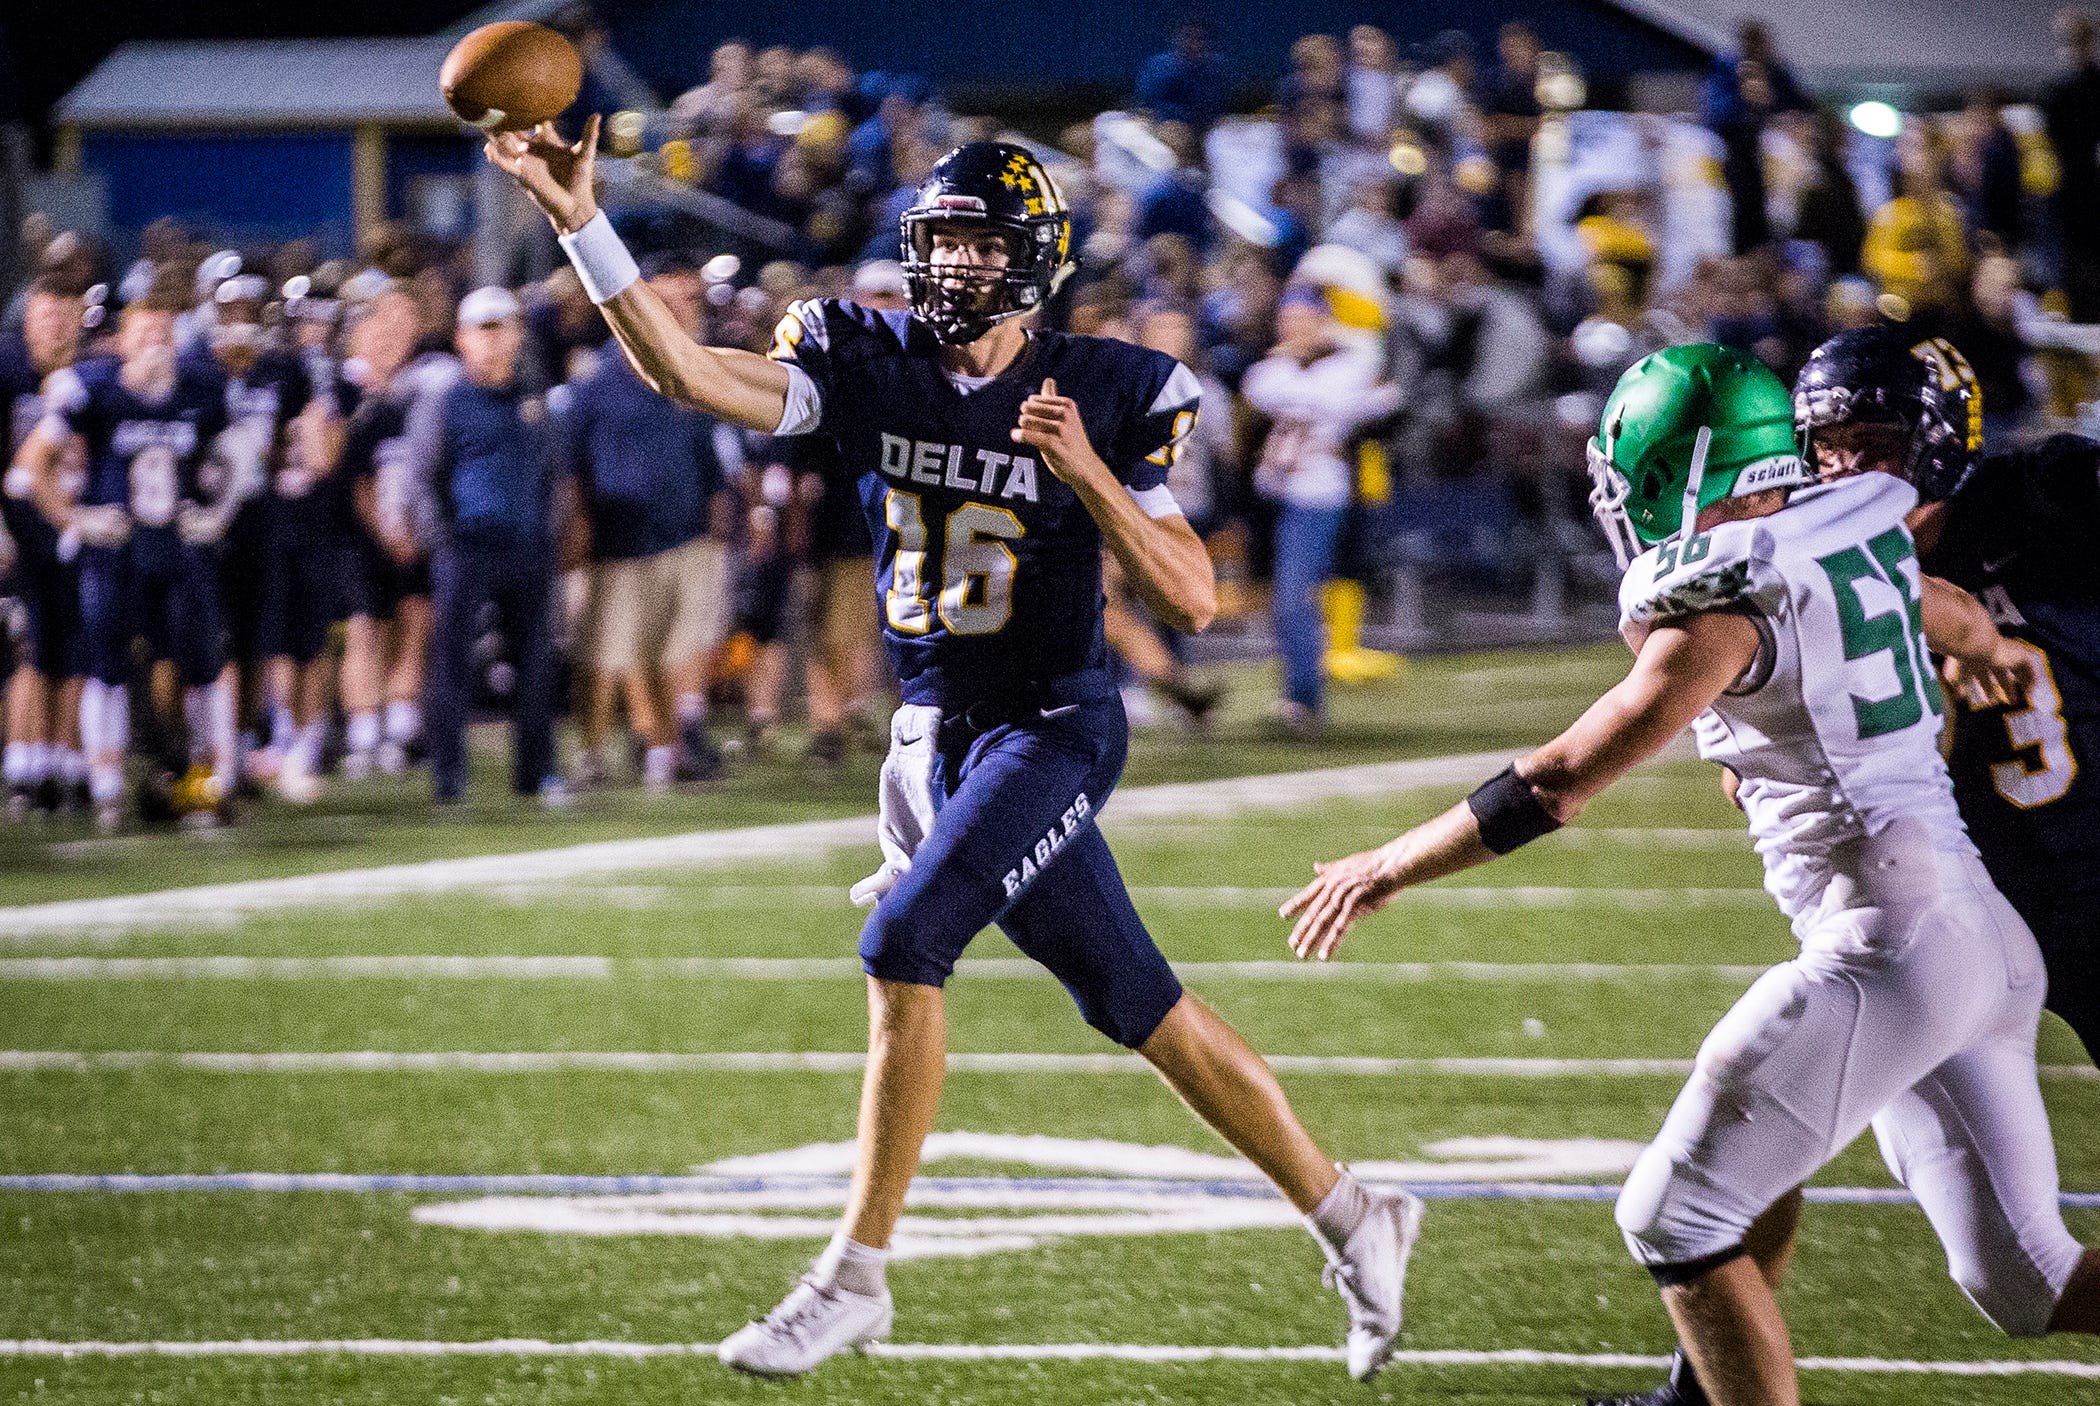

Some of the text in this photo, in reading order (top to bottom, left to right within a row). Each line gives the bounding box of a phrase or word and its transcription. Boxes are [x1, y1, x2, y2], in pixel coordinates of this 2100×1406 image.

[881, 432, 1039, 502] DELTA
[885, 487, 1026, 635] 16
[1932, 636, 2079, 811] 3
[1002, 792, 1091, 897] EAGLES
